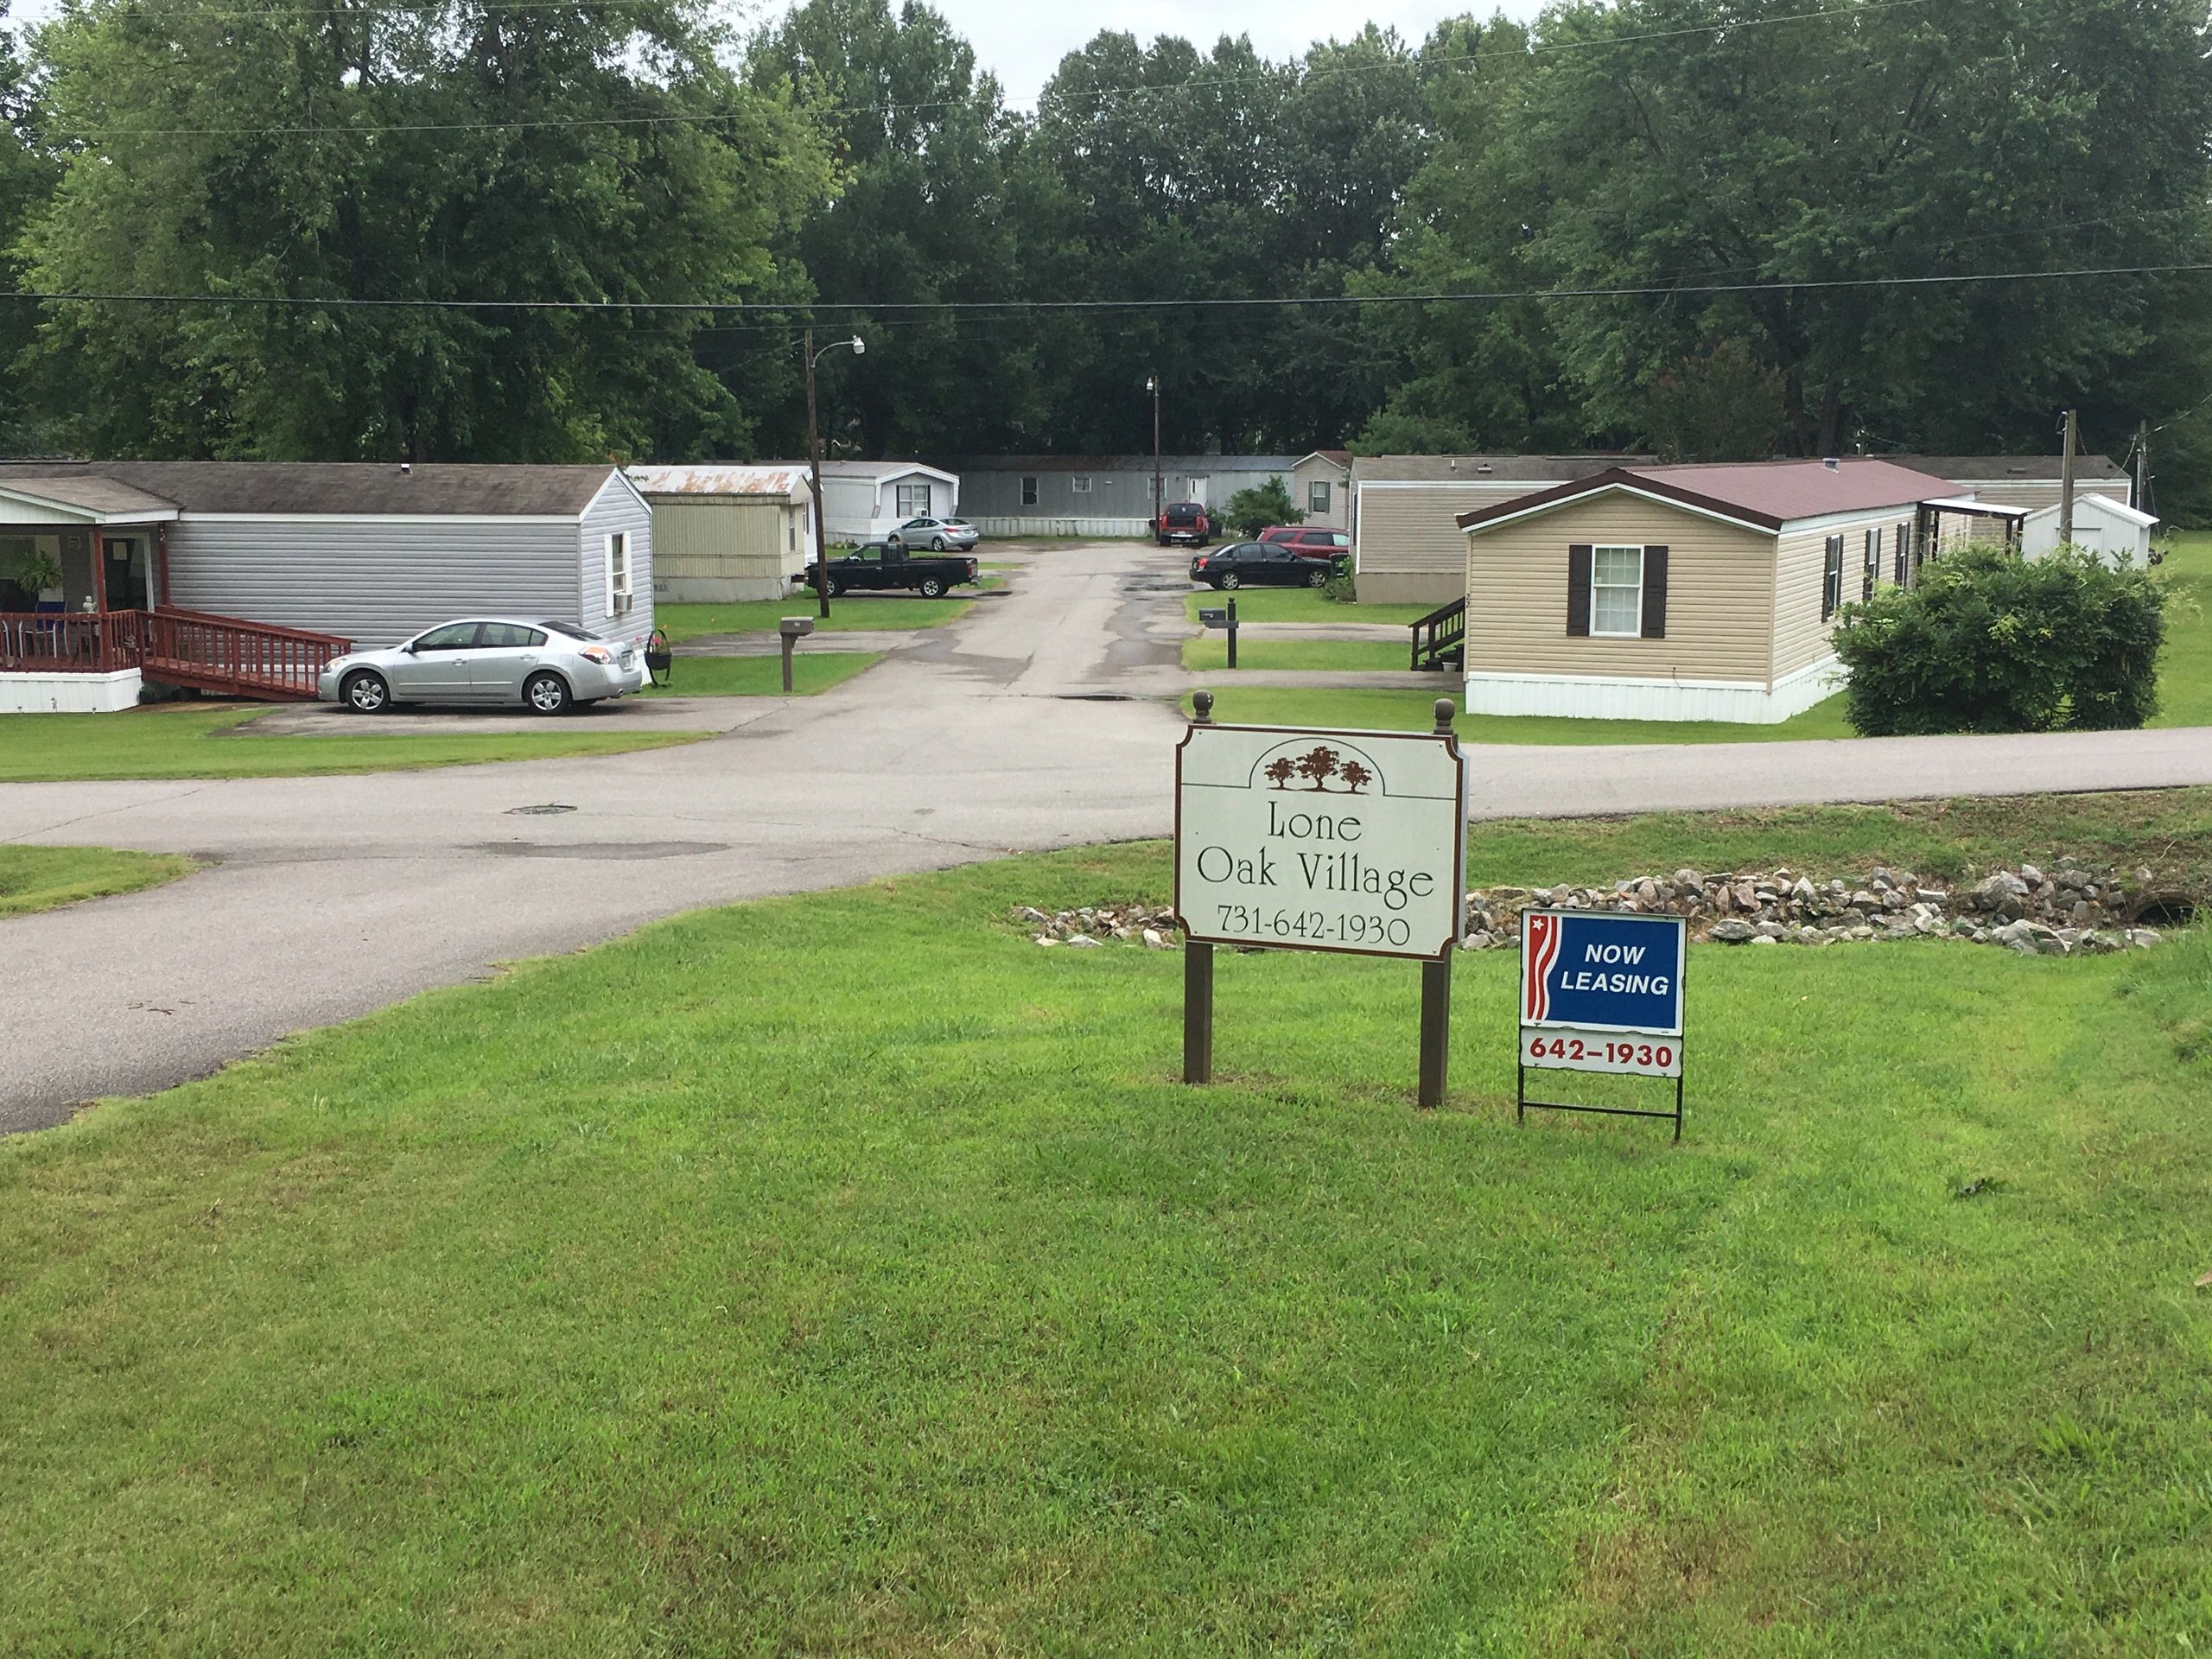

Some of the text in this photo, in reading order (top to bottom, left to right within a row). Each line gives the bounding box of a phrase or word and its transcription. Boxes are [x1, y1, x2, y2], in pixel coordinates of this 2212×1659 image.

[1268, 800, 1363, 842] Lone
[1197, 846, 1434, 911] Oak Village
[1217, 905, 1411, 946] 731-642-1930
[1585, 944, 1646, 965] NOW
[1560, 971, 1669, 995] LEASING
[1529, 1038, 1673, 1068] 642-1930
